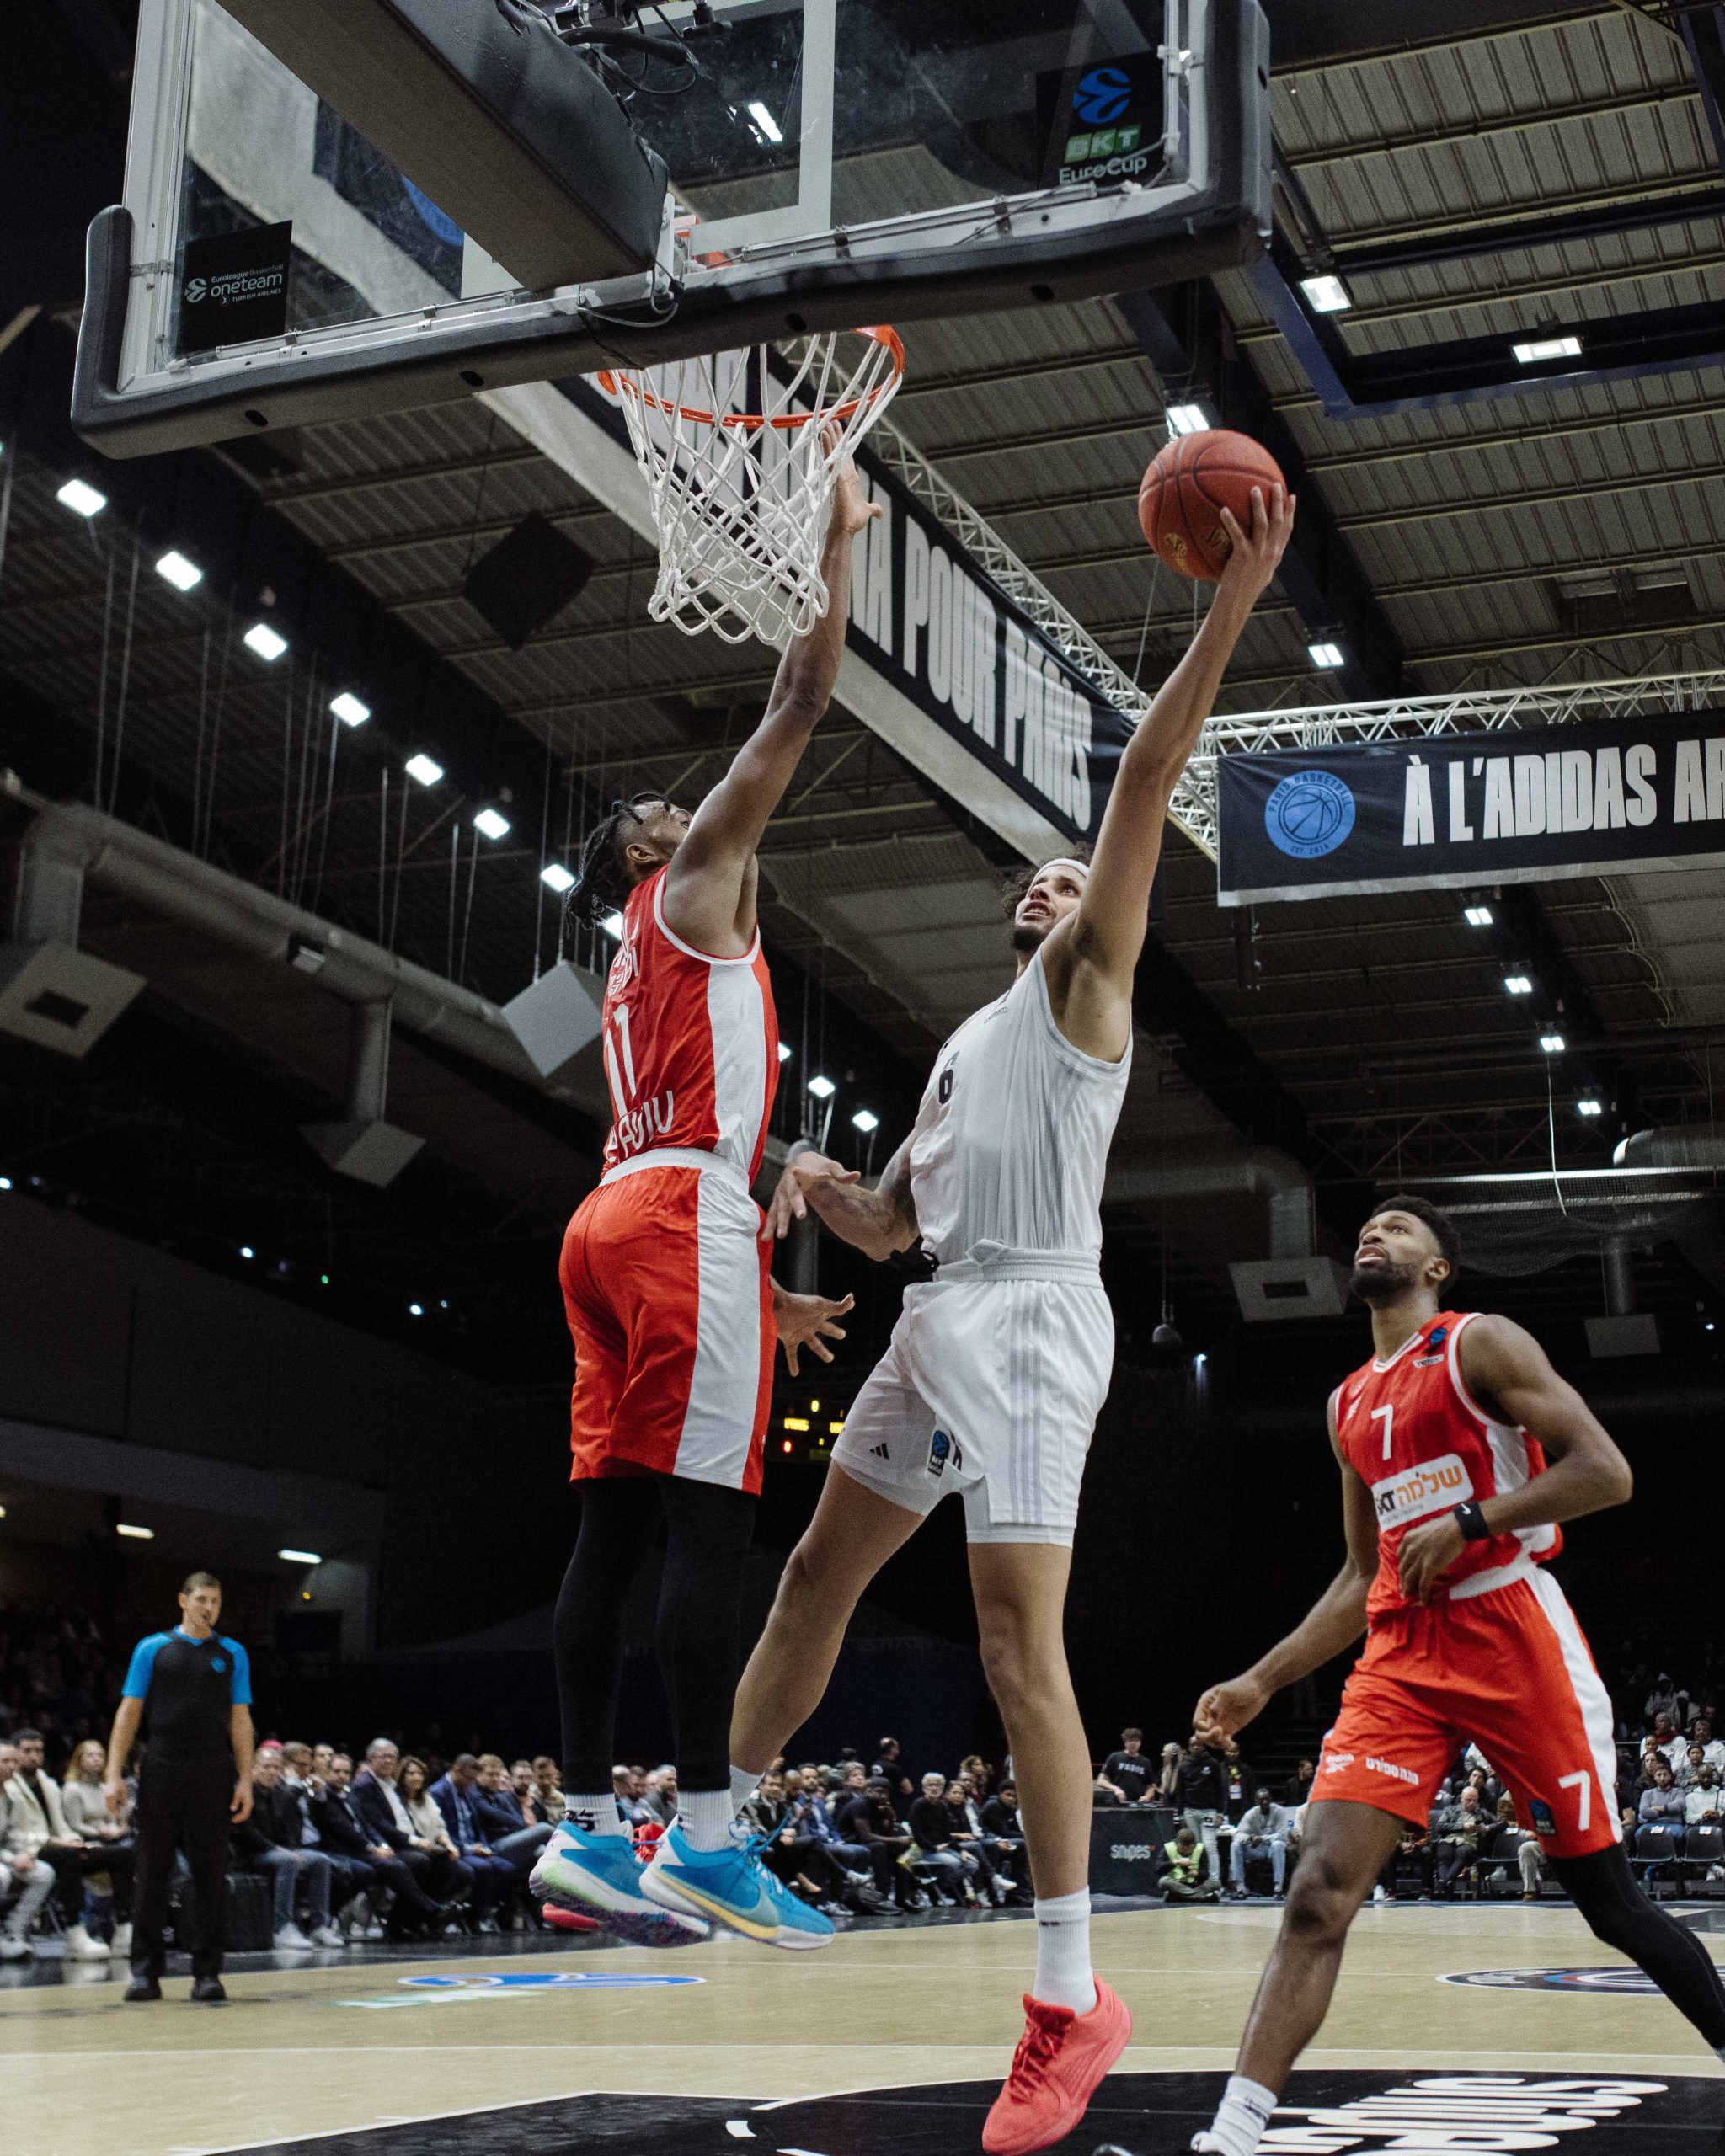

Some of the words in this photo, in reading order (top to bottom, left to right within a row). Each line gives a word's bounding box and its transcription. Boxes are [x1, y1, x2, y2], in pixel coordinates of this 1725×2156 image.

[1059, 157, 1147, 184] EuroCup
[1065, 128, 1140, 163] BKT
[211, 271, 250, 283] Euroleague
[250, 264, 284, 276] Basketball
[232, 293, 256, 302] TURKISH
[257, 288, 281, 297] AIRLINES
[903, 515, 997, 749] POUR
[1004, 616, 1092, 831] PARIS
[1403, 755, 1434, 846] À
[1449, 744, 1657, 842] L'ADIDAS
[1370, 1403, 1393, 1460] 7
[1558, 1769, 1590, 1831] 7
[1253, 2077, 1669, 2156] snipe
